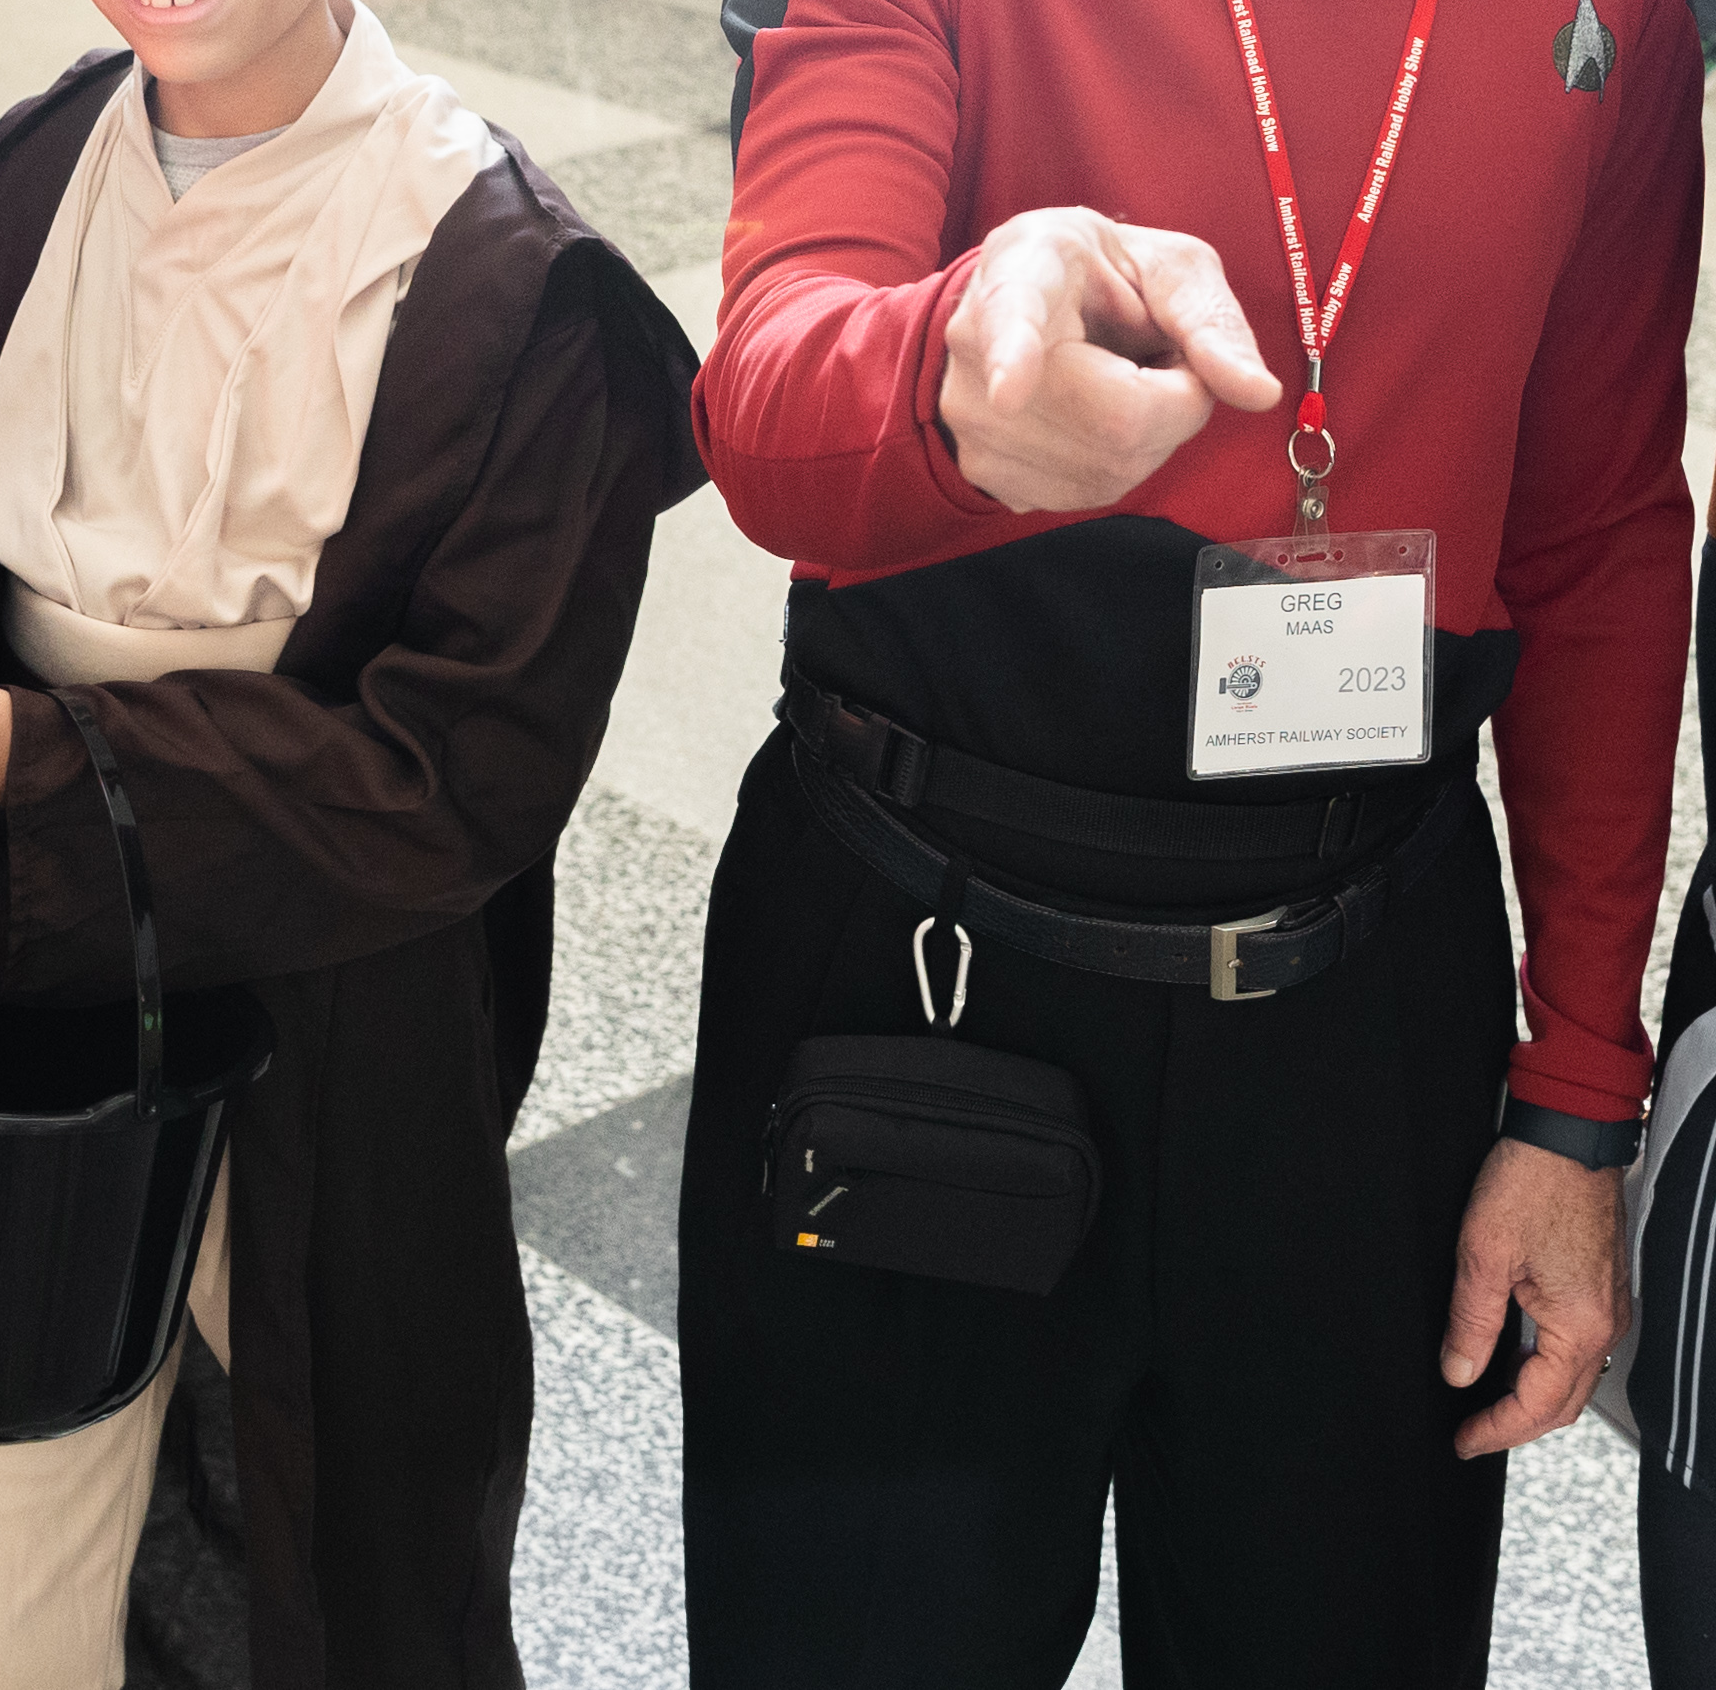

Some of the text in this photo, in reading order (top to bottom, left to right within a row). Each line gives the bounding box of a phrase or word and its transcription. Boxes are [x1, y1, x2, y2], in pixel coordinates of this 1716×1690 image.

[1237, 18, 1264, 74] Railroad
[1251, 75, 1271, 116] Hobby
[1261, 117, 1279, 152] Show
[1357, 37, 1425, 224] Amherst Railroad Hobby Show
[1278, 196, 1302, 250] Amherst
[1289, 251, 1312, 305] Railroad
[1330, 262, 1353, 297] Show
[1299, 306, 1316, 346] Hobby
[1281, 592, 1343, 613] GREG
[1286, 619, 1334, 636] MAAS
[1338, 666, 1407, 693] 2023
[1205, 725, 1408, 747] AMHERST RAILWAY SOCIETY
